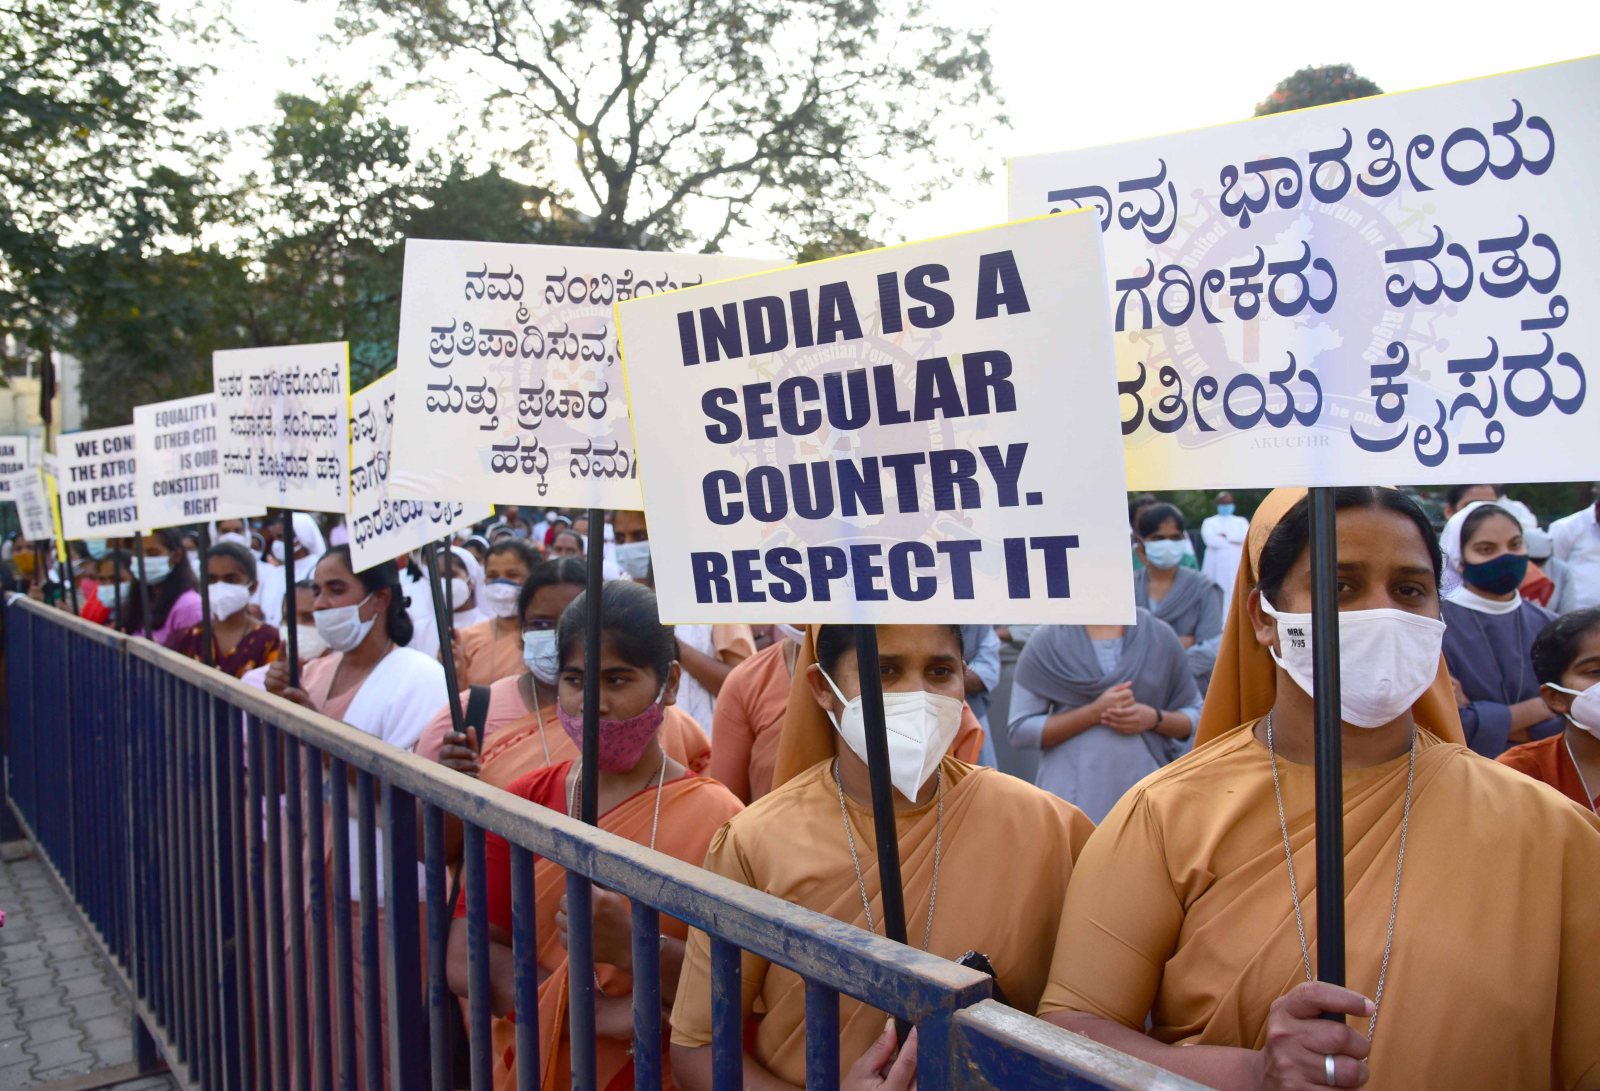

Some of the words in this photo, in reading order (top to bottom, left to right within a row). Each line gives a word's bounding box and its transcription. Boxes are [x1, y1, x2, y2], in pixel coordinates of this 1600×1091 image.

[1220, 98, 1555, 229] ಭಾರತೀಯ
[465, 262, 531, 324] ನಮ್ಮ
[1385, 215, 1568, 335] ಮತ್ತು
[677, 281, 863, 367] INDIA
[877, 264, 954, 334] IS
[976, 250, 1030, 319] A
[155, 404, 208, 428] EQUALITY
[427, 375, 498, 430] ಮತ್ತು
[518, 378, 608, 430] ಪ್ರಚಾರ
[702, 349, 1016, 444] SECULAR
[1350, 332, 1586, 467] ಕ್ರೈಸ್ತರು
[75, 440, 99, 458] WE
[103, 434, 136, 454] CON
[154, 431, 190, 451] OTHER
[180, 453, 191, 470] IS
[194, 449, 218, 468] OUR
[491, 437, 548, 496] ಹಕ್ಕು
[67, 487, 87, 507] ON
[91, 482, 135, 504] PEACE
[70, 464, 97, 483] THE
[703, 443, 1042, 525] COUNTRY.
[183, 496, 218, 517] RIGHT
[691, 540, 982, 603] RESPECT
[1004, 535, 1079, 598] IT
[1288, 628, 1304, 637] MRK
